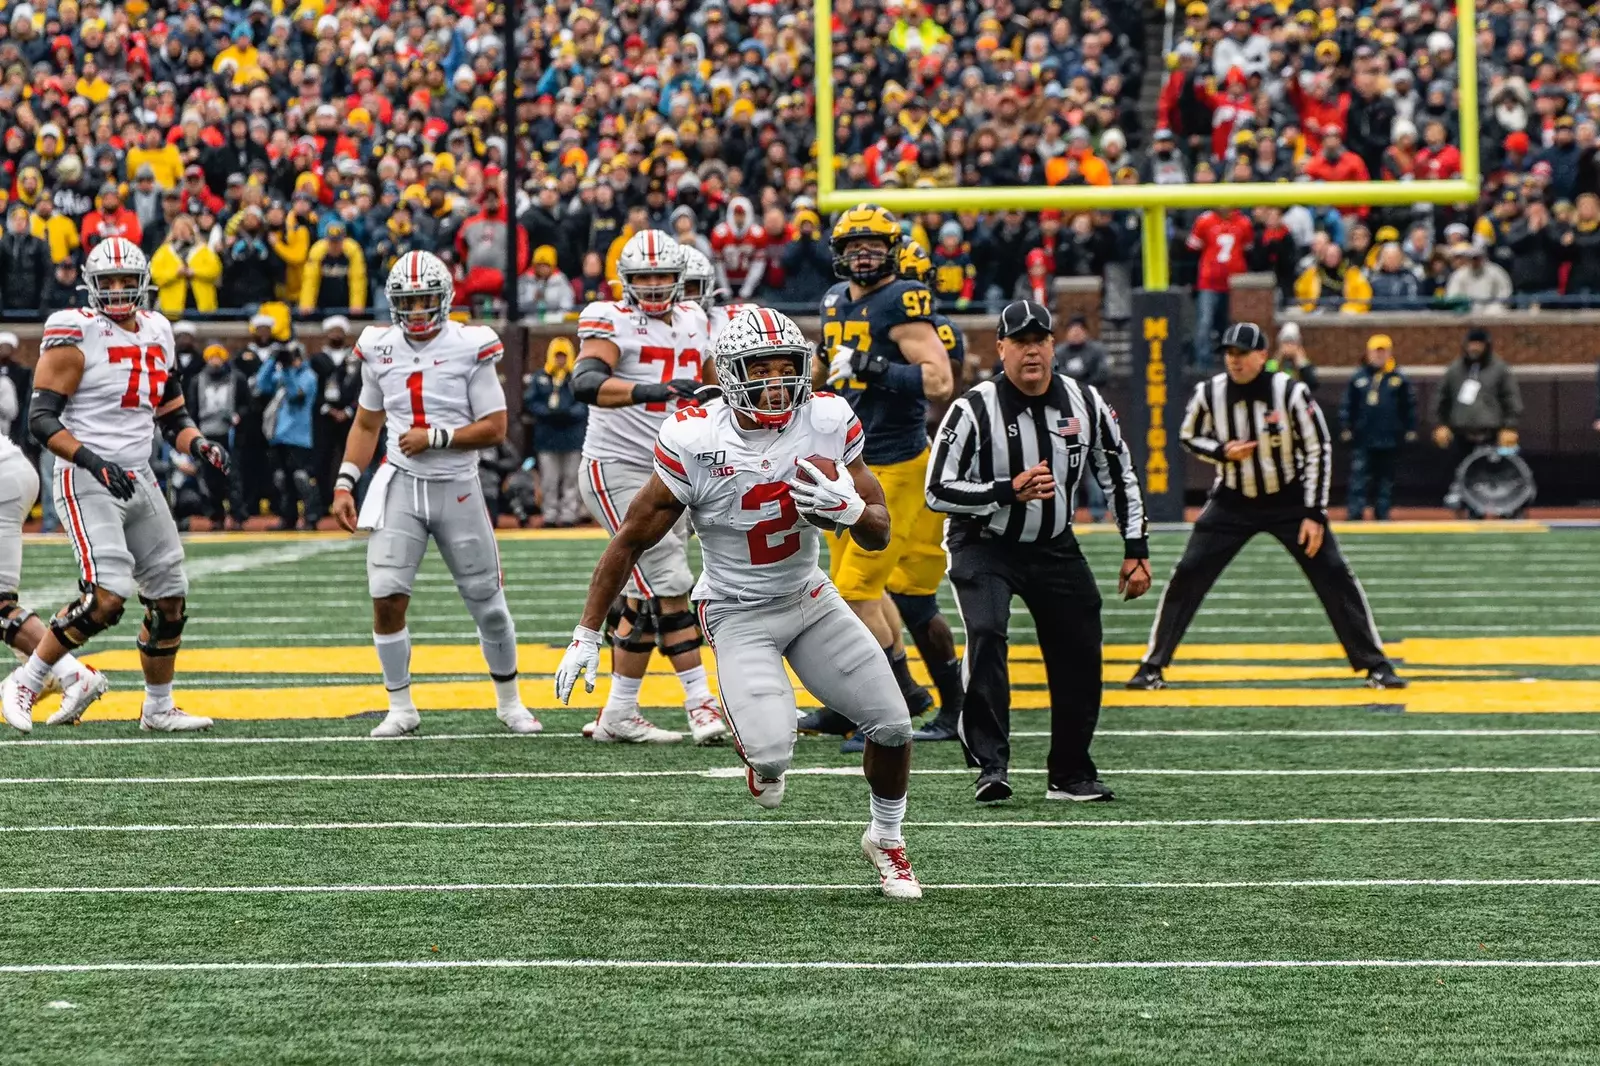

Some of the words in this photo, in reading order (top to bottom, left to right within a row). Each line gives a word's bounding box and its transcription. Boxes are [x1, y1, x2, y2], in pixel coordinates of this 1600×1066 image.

[1216, 233, 1235, 263] 7
[902, 289, 932, 317] 97
[107, 345, 168, 409] 76
[639, 346, 703, 412] 73
[406, 371, 431, 428] 1
[1143, 316, 1168, 494] MICHIGAN
[675, 408, 708, 423] 2
[1007, 424, 1019, 437] S
[694, 450, 726, 468] 150
[1069, 453, 1080, 468] U
[741, 480, 801, 566] 2
